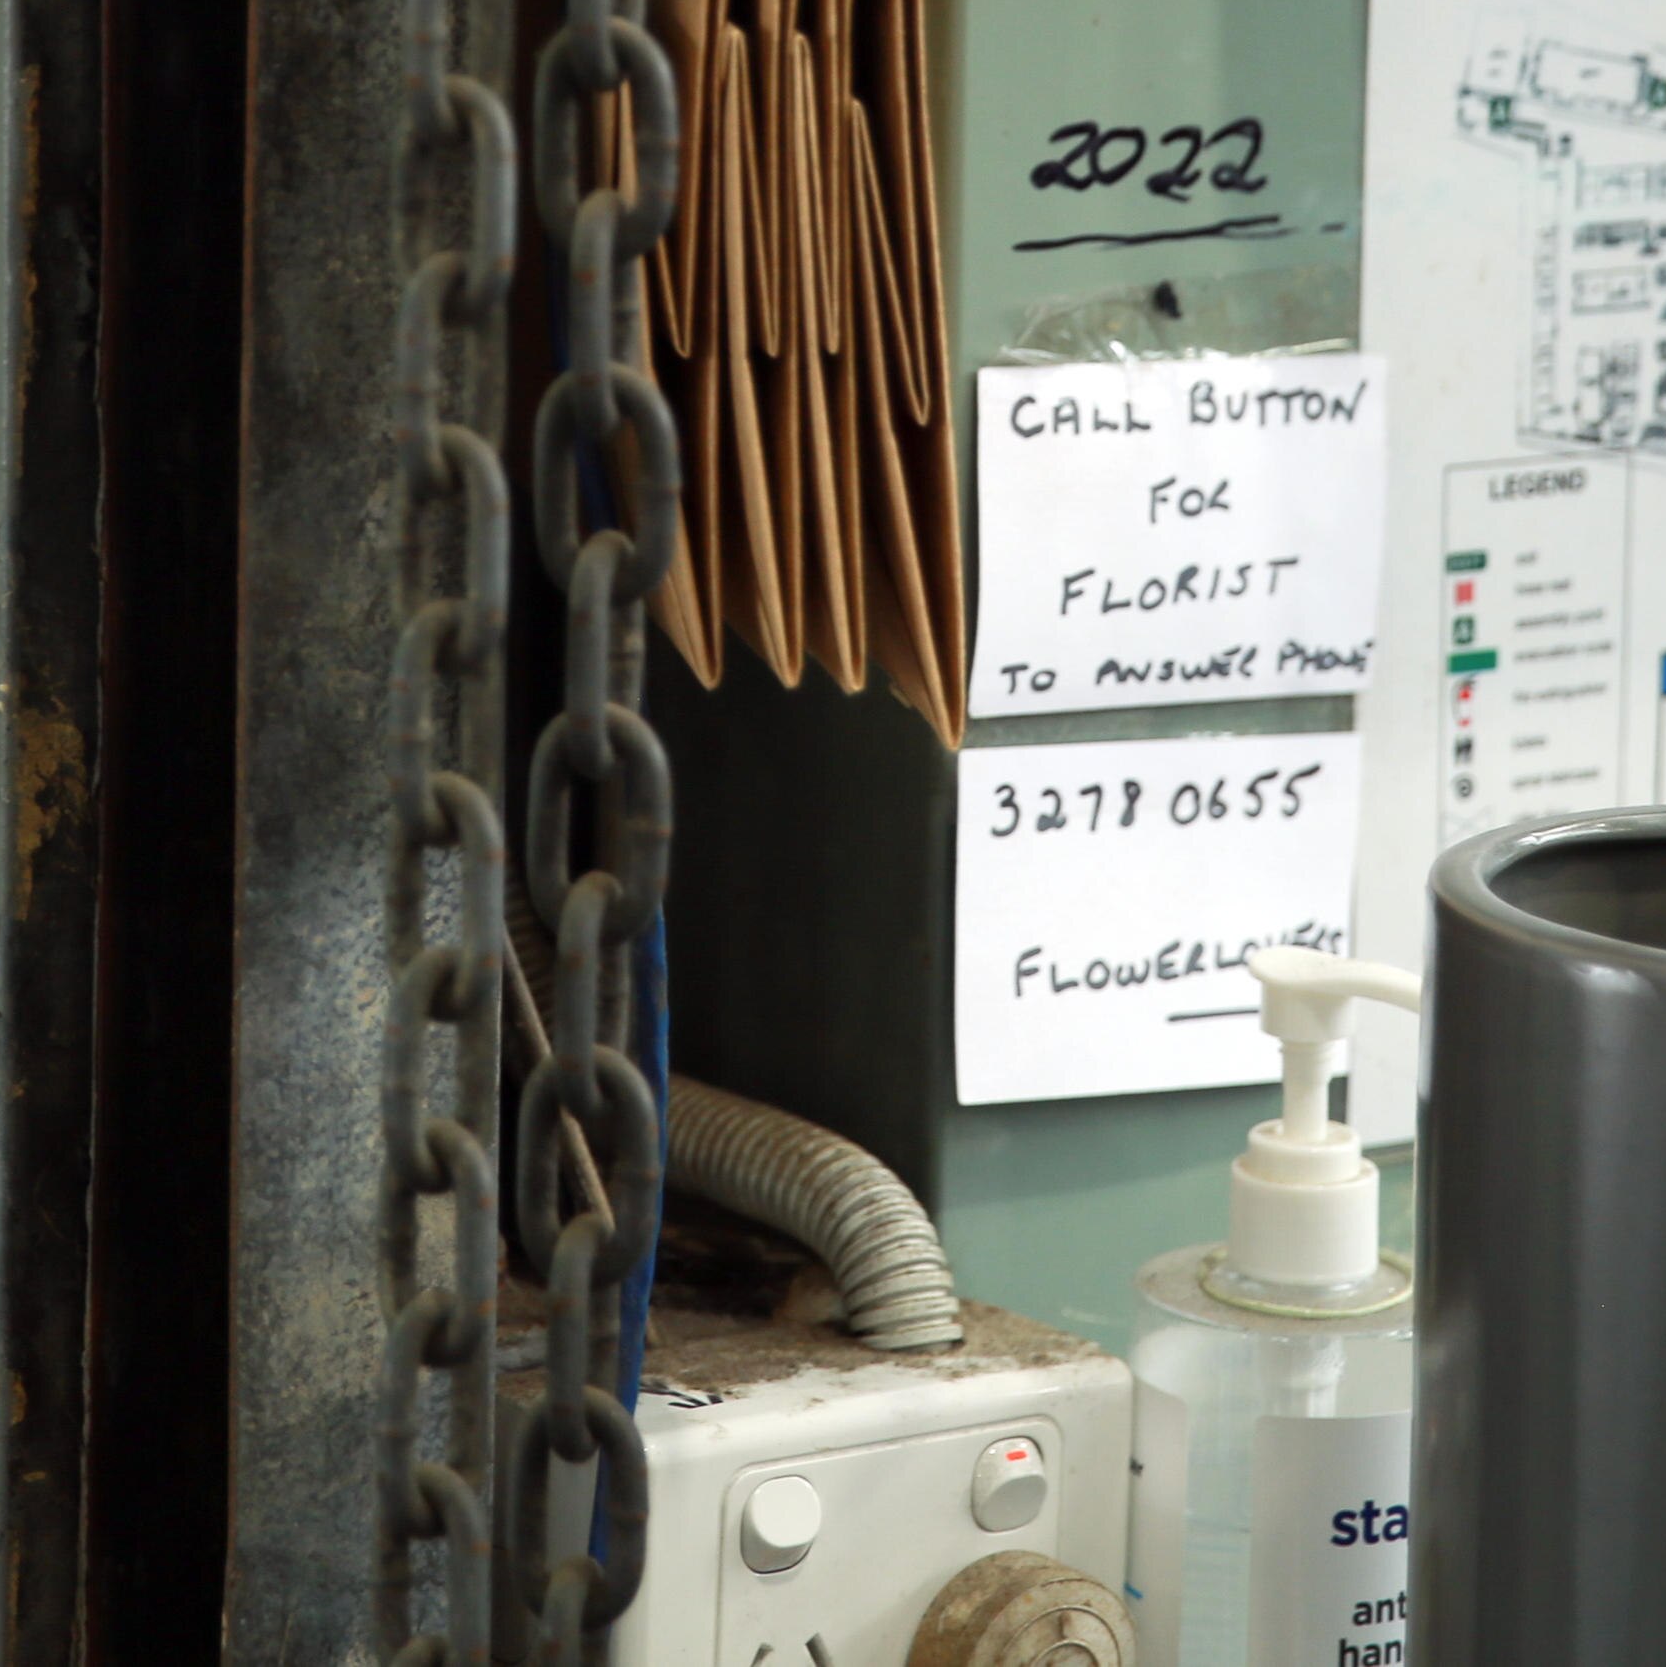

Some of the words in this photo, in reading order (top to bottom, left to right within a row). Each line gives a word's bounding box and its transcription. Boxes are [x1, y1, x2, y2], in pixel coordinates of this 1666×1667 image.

[1030, 117, 1268, 202] 2022
[1010, 396, 1151, 438] CALL
[1188, 380, 1369, 427] BUTTON
[1488, 466, 1588, 503] LEGEND
[1060, 556, 1299, 616] FLORIST
[1001, 664, 1057, 694] TO
[1095, 641, 1257, 687] ANSWER
[991, 778, 1142, 838] 3278
[1170, 762, 1322, 827] 0655
